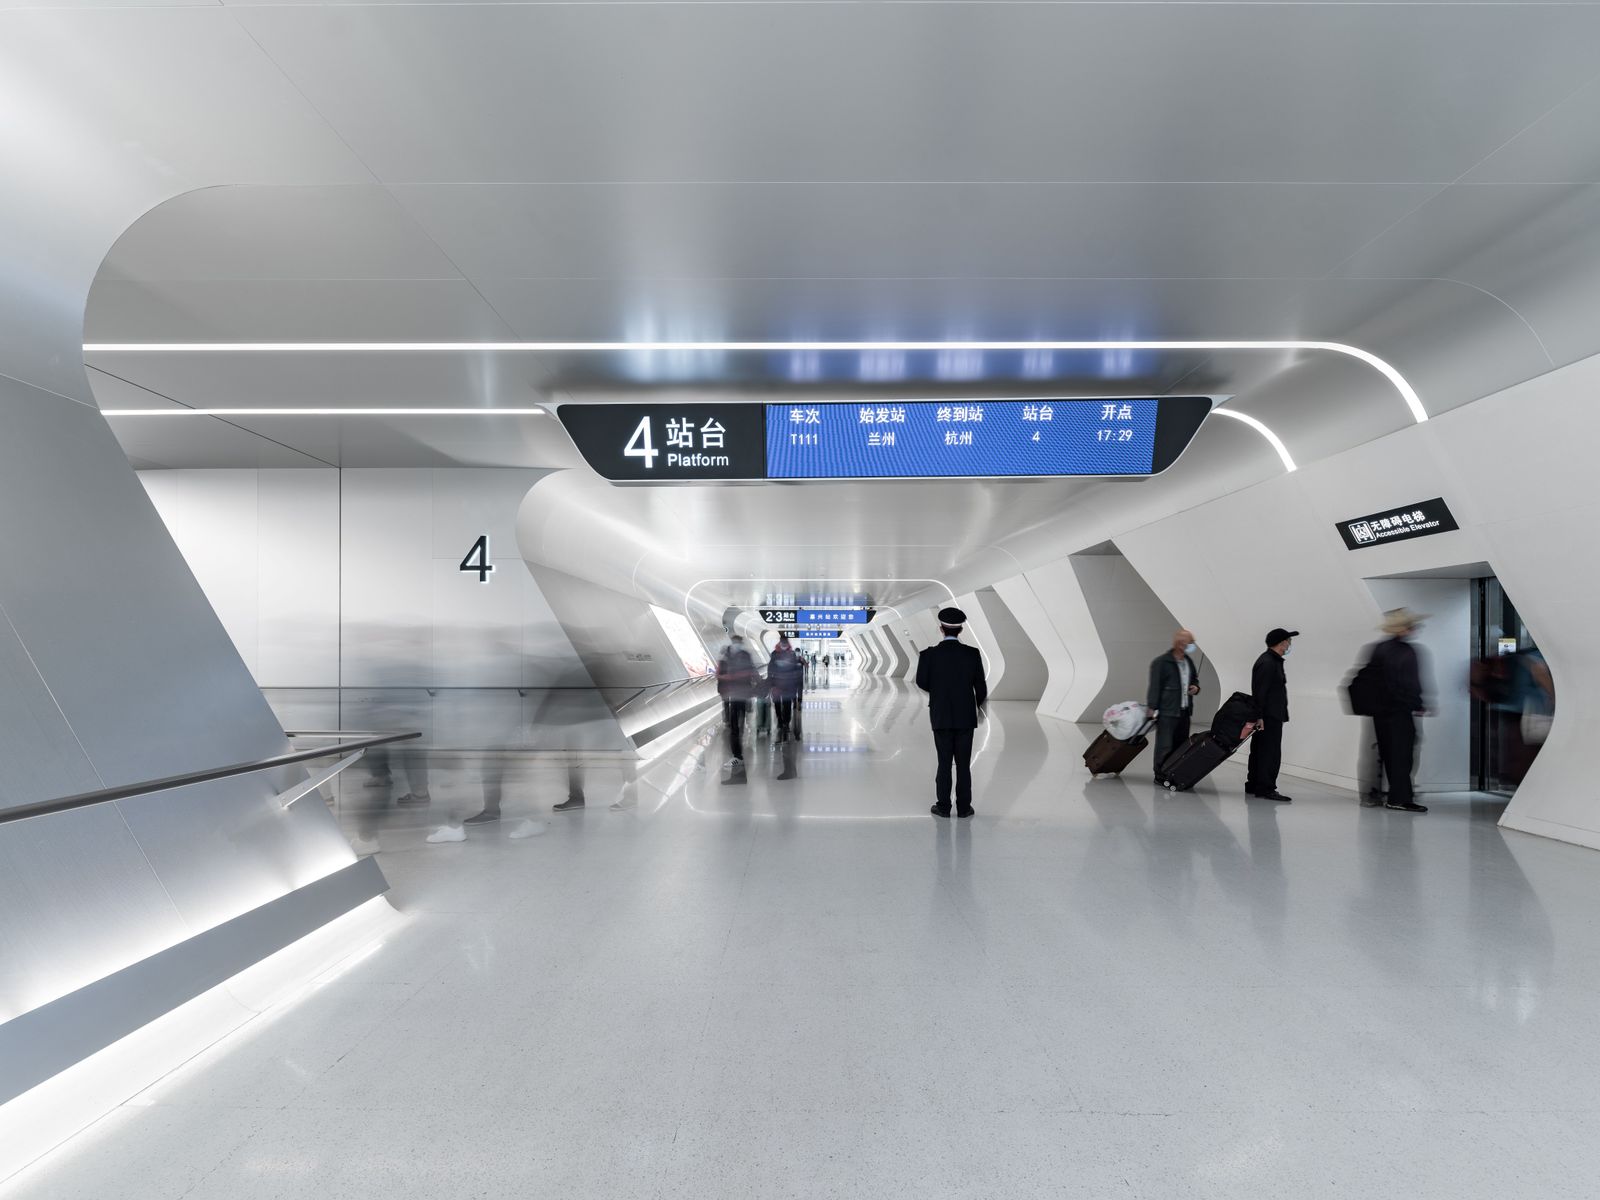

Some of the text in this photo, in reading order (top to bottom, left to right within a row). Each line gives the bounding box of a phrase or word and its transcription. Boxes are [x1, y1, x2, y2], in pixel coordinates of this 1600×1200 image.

[789, 404, 1132, 424] 车次 始发站 终到站 站台 开点
[623, 415, 659, 469] 4
[665, 417, 727, 449] 站台
[790, 429, 1133, 446] T111 兰州 杭州 4 17:29
[667, 453, 729, 467] Platform
[1371, 510, 1426, 531] 无障碍电梯
[1376, 520, 1440, 538] Accessible Elevator
[460, 535, 496, 584] 4
